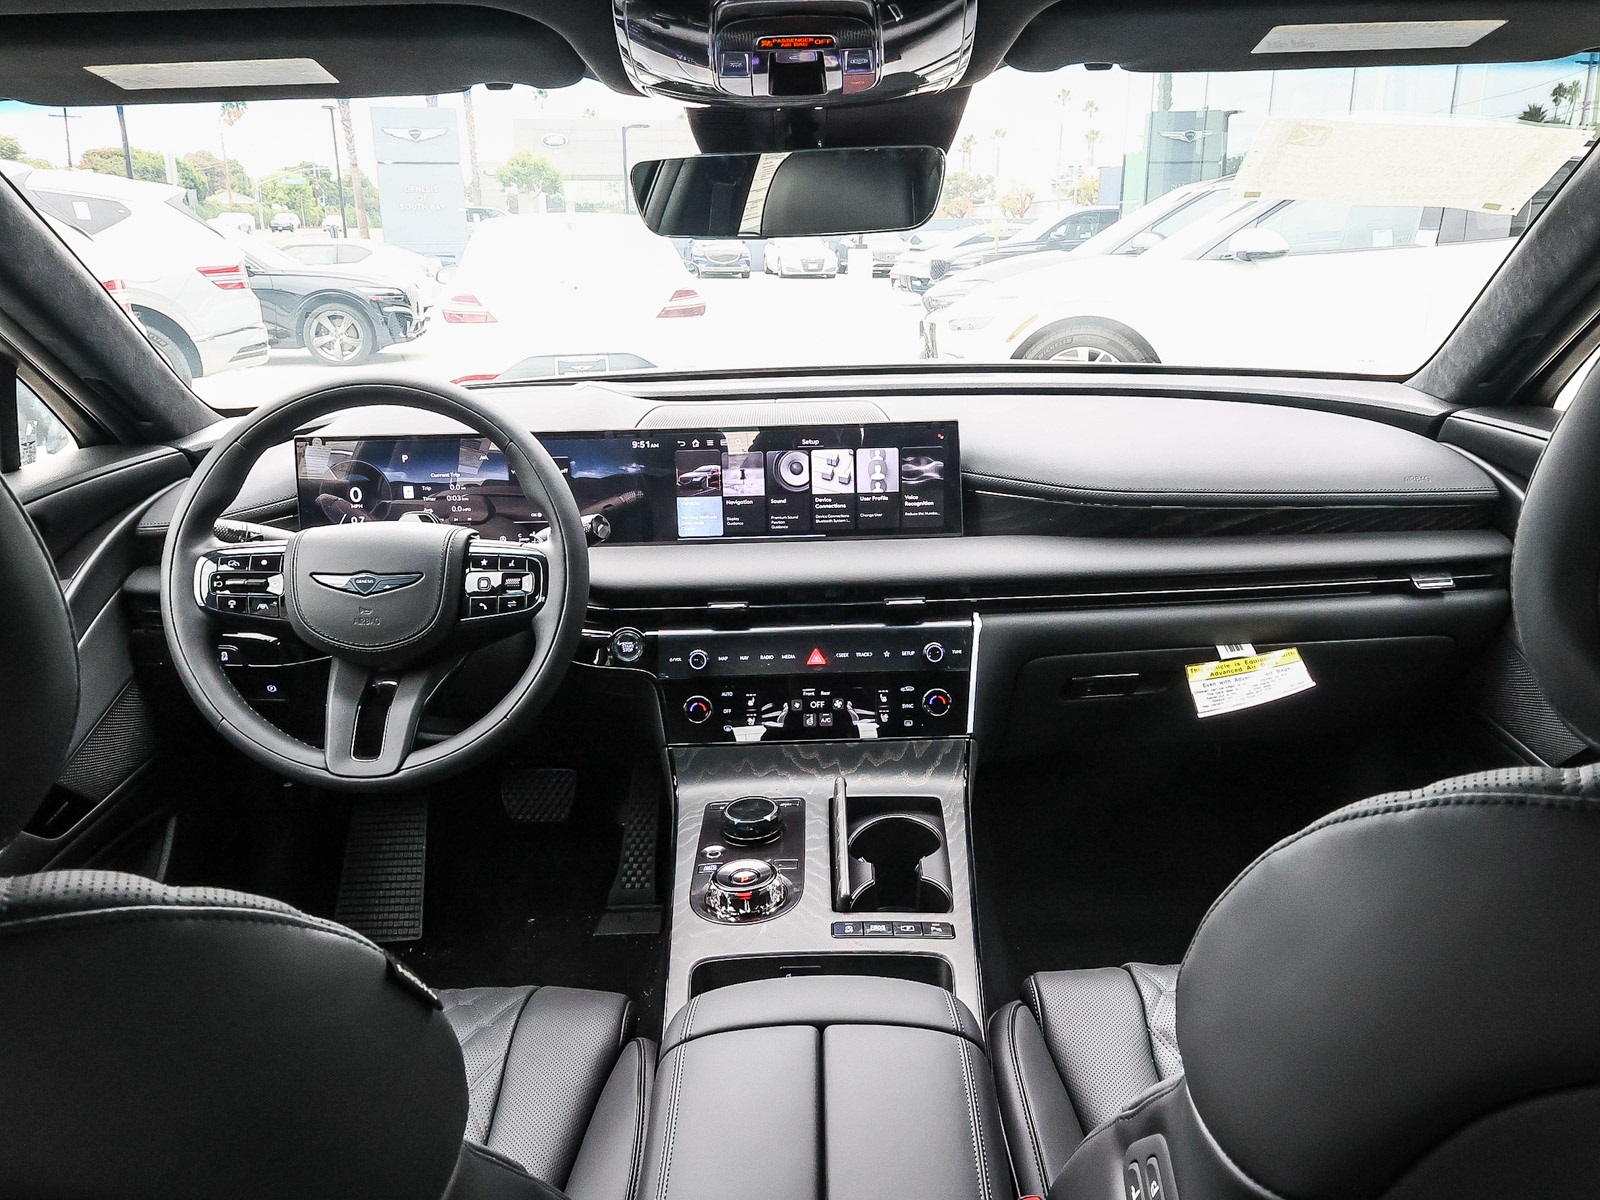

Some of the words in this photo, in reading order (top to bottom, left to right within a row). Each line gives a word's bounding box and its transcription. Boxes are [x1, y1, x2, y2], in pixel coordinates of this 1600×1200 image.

[403, 185, 439, 193] GENESIS
[416, 194, 426, 202] OF
[400, 203, 430, 211] SOUTH
[801, 438, 820, 446] Setup
[401, 454, 409, 463] P
[349, 486, 363, 503] 0
[725, 498, 754, 506] Navigation
[352, 616, 381, 626] AIRBAG
[1209, 667, 1244, 677] Advanced
[809, 700, 825, 709] OFF
